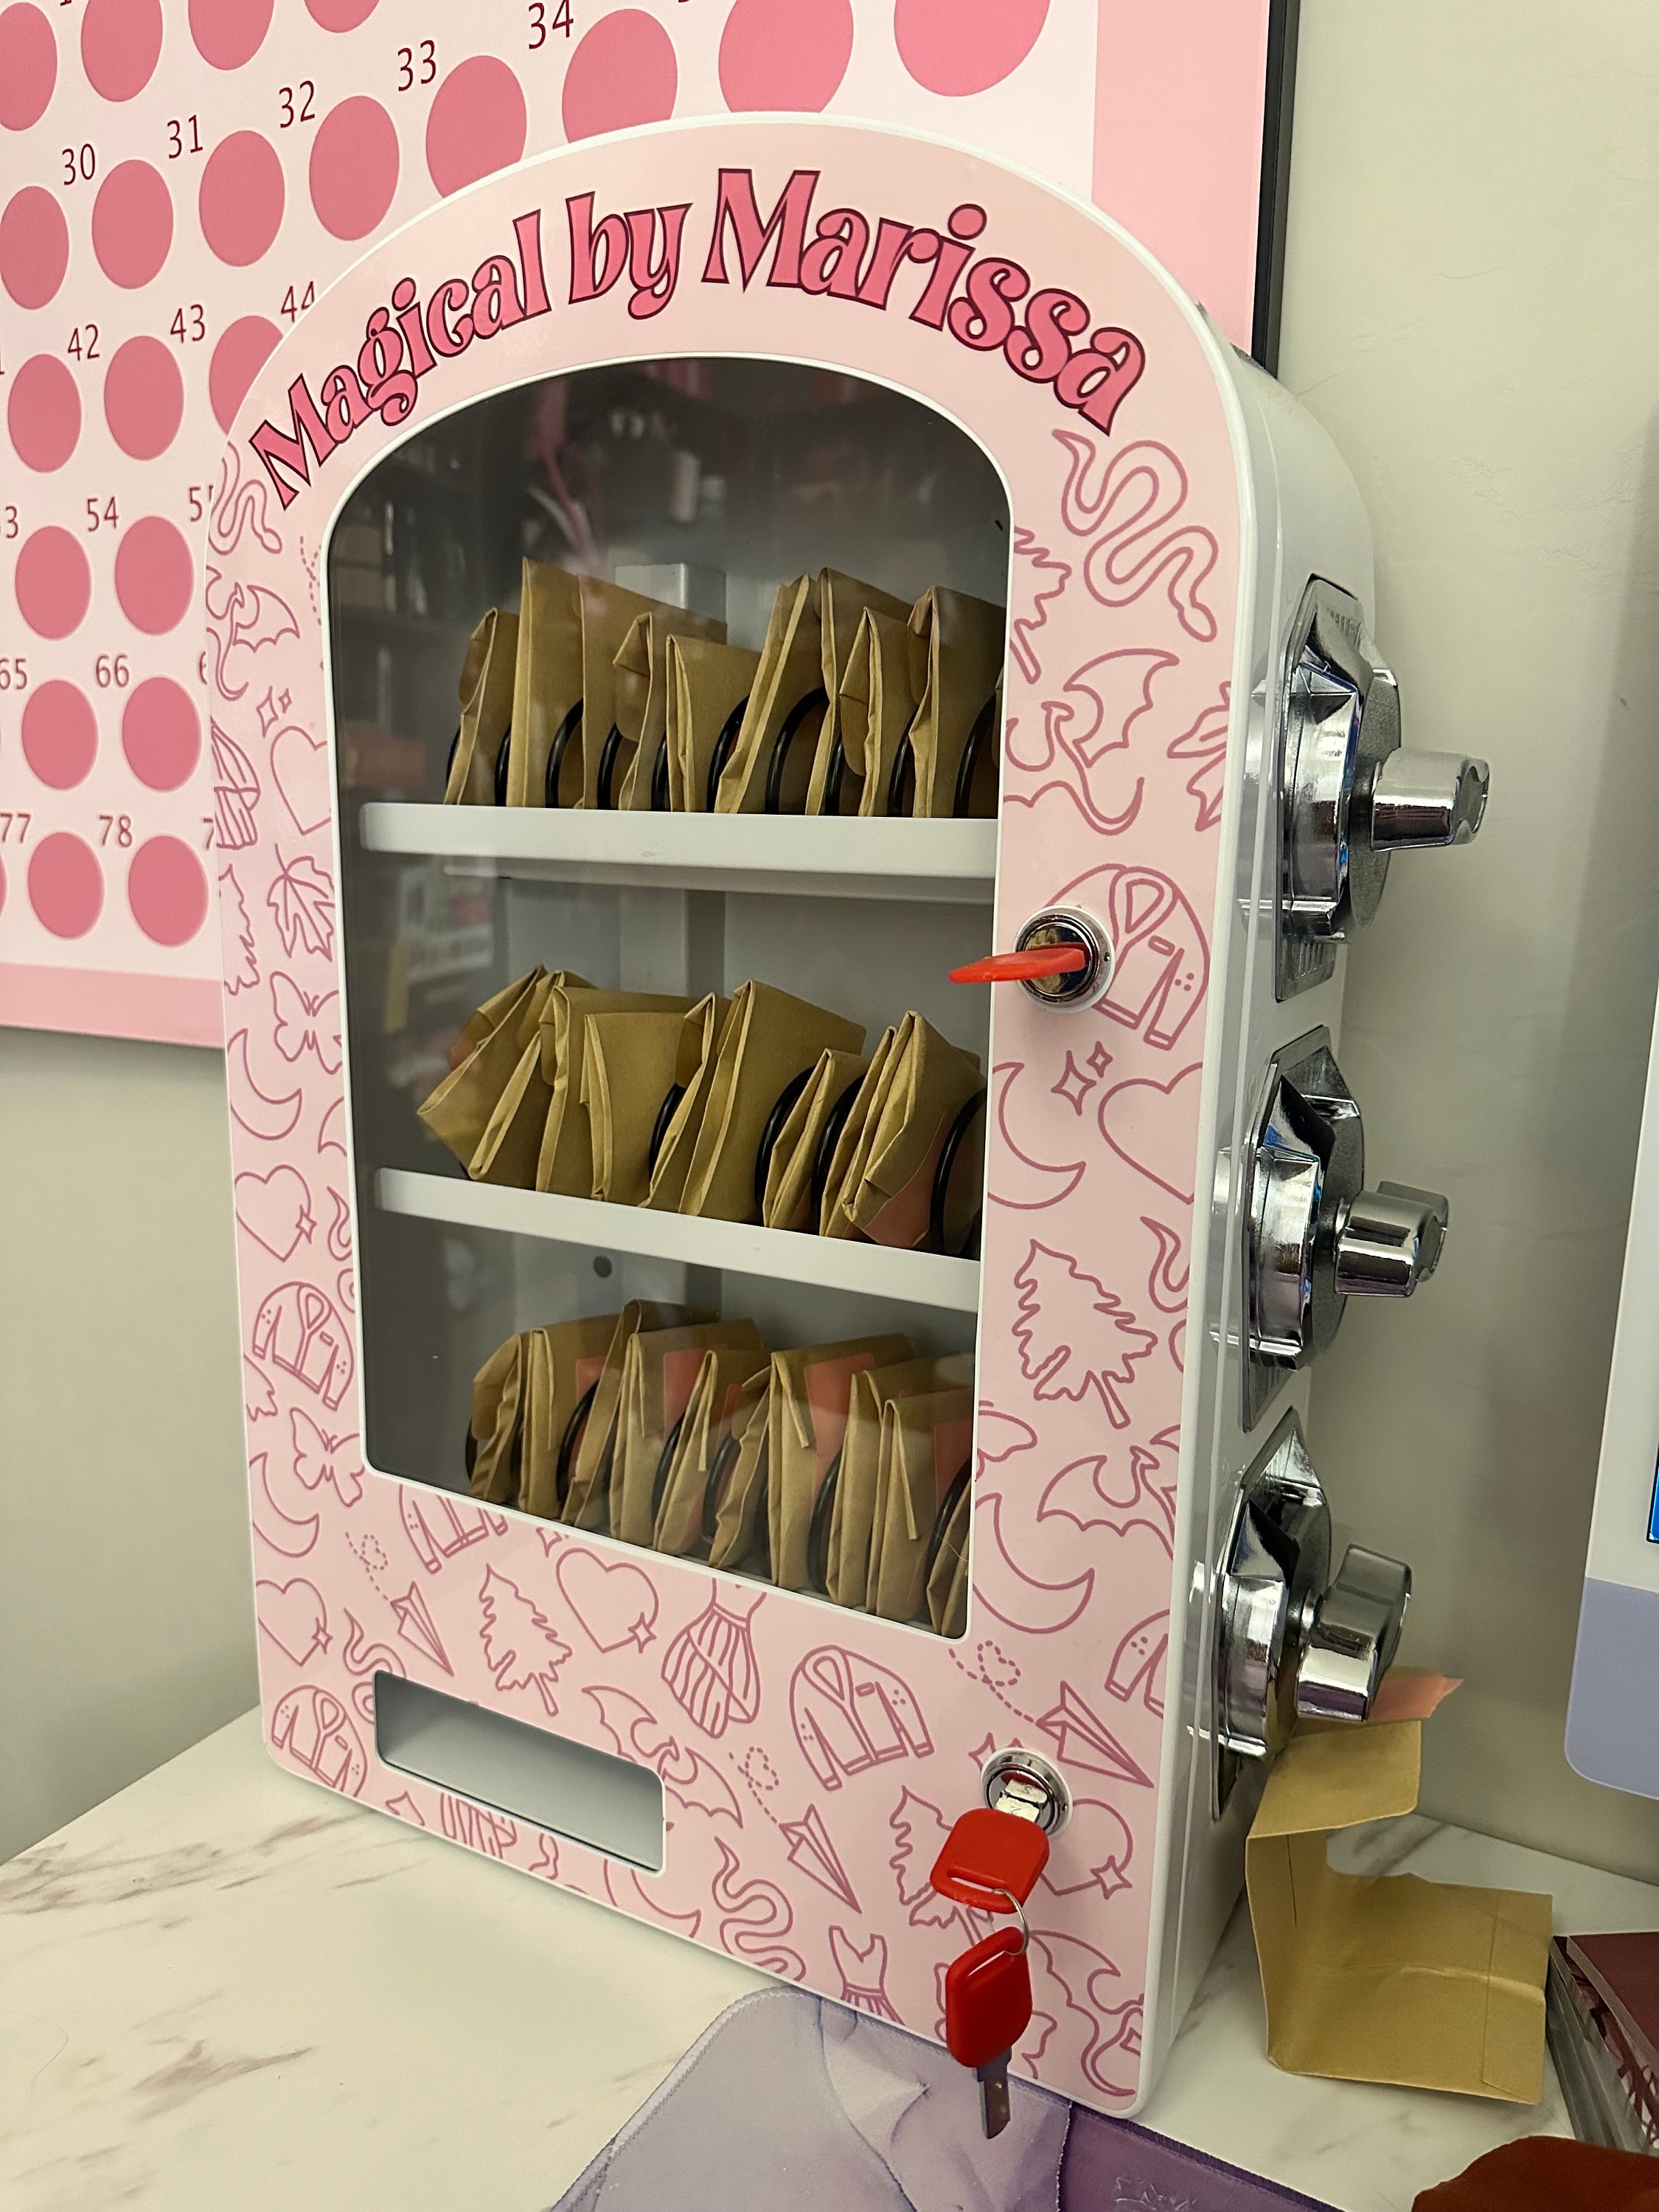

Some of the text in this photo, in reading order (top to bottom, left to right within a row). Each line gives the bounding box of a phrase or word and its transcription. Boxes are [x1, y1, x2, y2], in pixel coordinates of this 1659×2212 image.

[529, 0, 574, 49] 34
[397, 40, 437, 91] 33
[279, 80, 316, 128] 32
[167, 115, 204, 159] 31
[62, 144, 96, 185] 30
[67, 324, 100, 361] 42
[170, 305, 206, 343] 43
[248, 167, 1146, 511] Magical by Marissa
[0, 506, 18, 539] 3
[86, 496, 119, 532] 54
[0, 654, 130, 690] 65 66
[0, 813, 215, 850] 77 78 7
